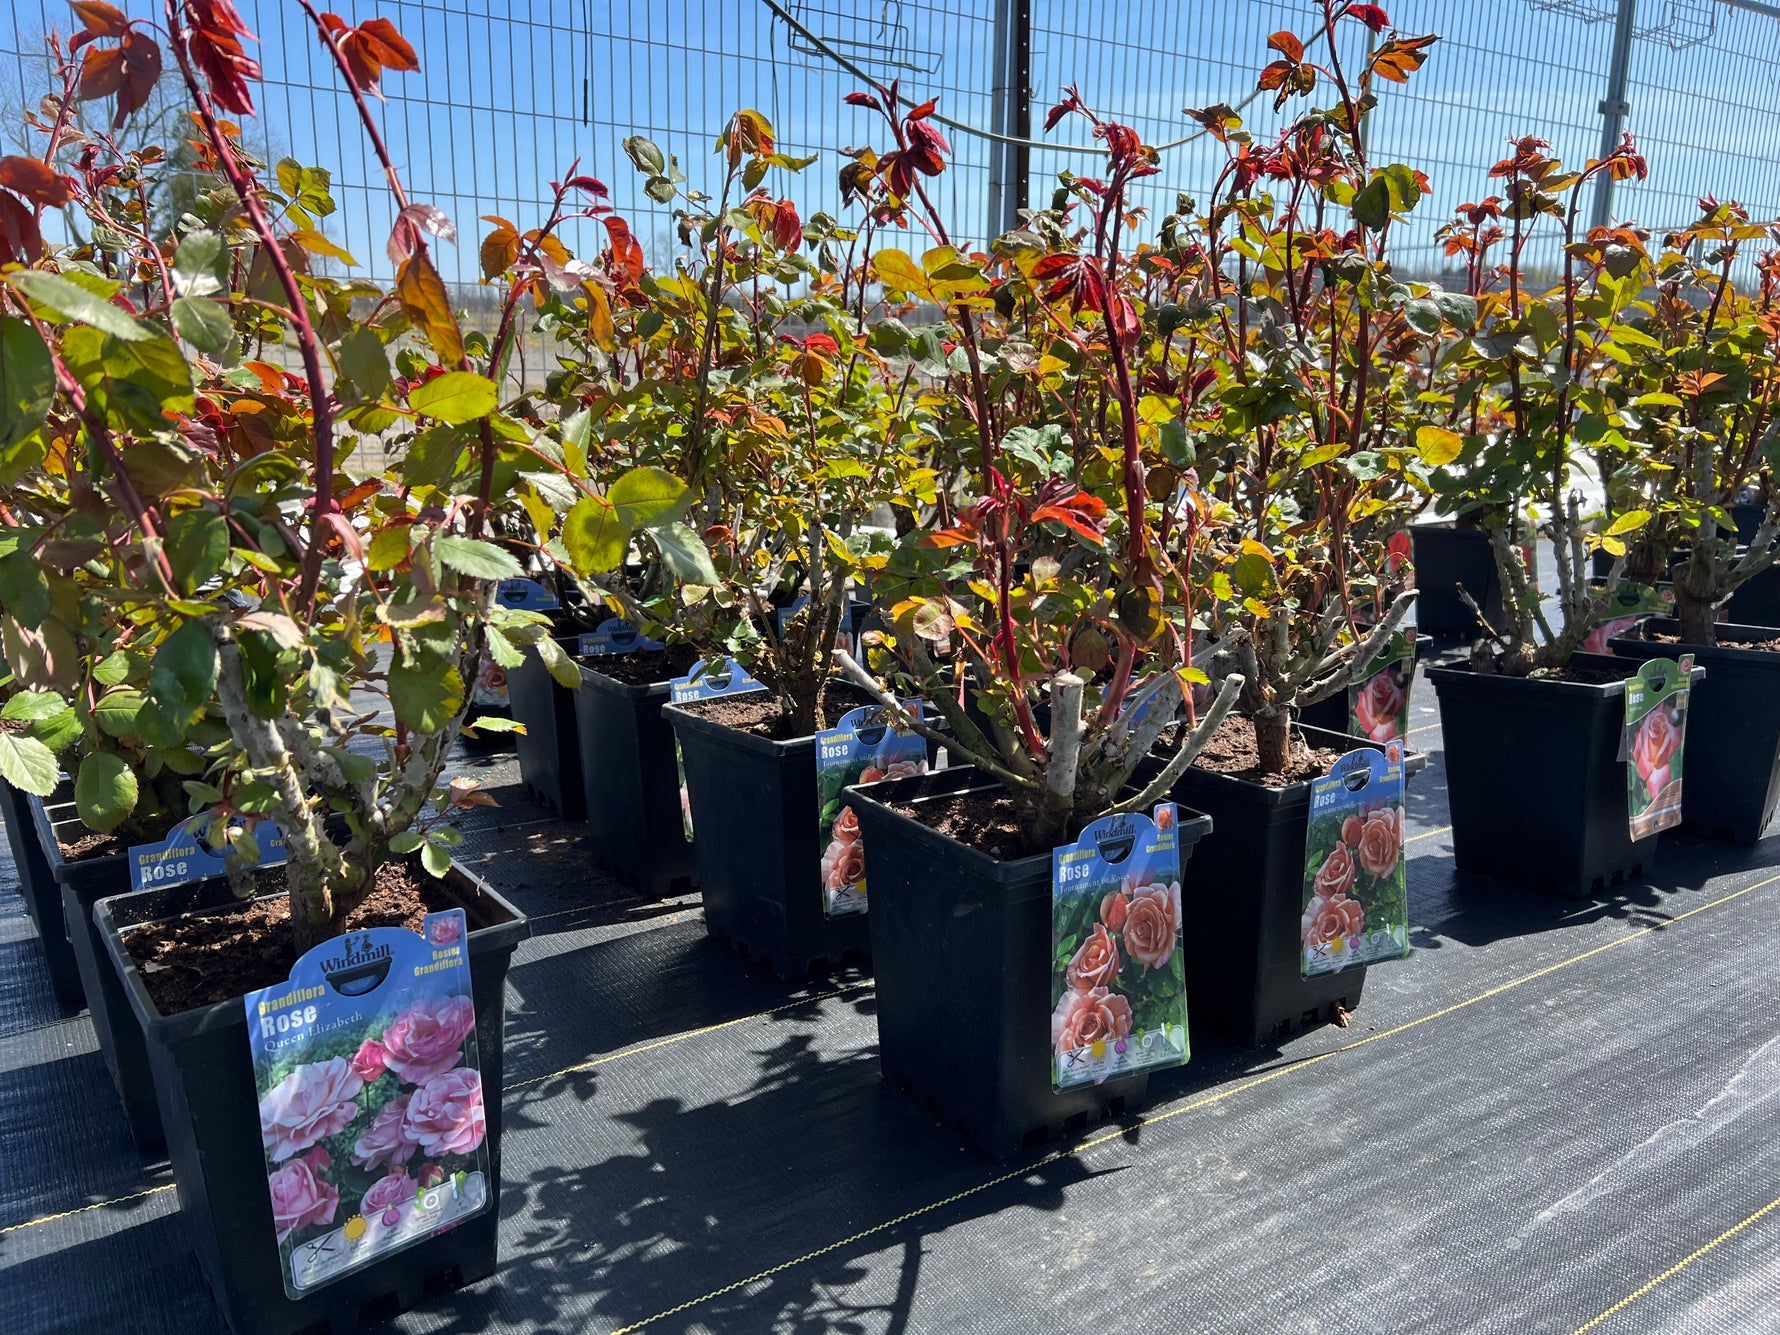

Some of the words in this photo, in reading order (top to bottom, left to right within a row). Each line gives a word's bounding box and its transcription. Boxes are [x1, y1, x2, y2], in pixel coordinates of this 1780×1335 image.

[583, 644, 605, 654] Rose
[675, 690, 699, 703] Rose
[821, 744, 848, 759] Rose
[1313, 792, 1336, 809] Rose
[1094, 824, 1136, 841] Windmill
[138, 845, 196, 865] Grandiflora
[1058, 848, 1096, 864] Grandiflora
[140, 860, 188, 884] Rose
[1059, 863, 1089, 883] Rose
[1060, 879, 1100, 895] Tournament
[319, 943, 392, 975] Windmill
[432, 946, 461, 961] Rosier
[413, 956, 463, 977] Grandiflora
[257, 984, 326, 1017] Grandiflora
[260, 1003, 318, 1040] Rose
[264, 1031, 305, 1053] Queen
[308, 1010, 364, 1037] Elizabeth
